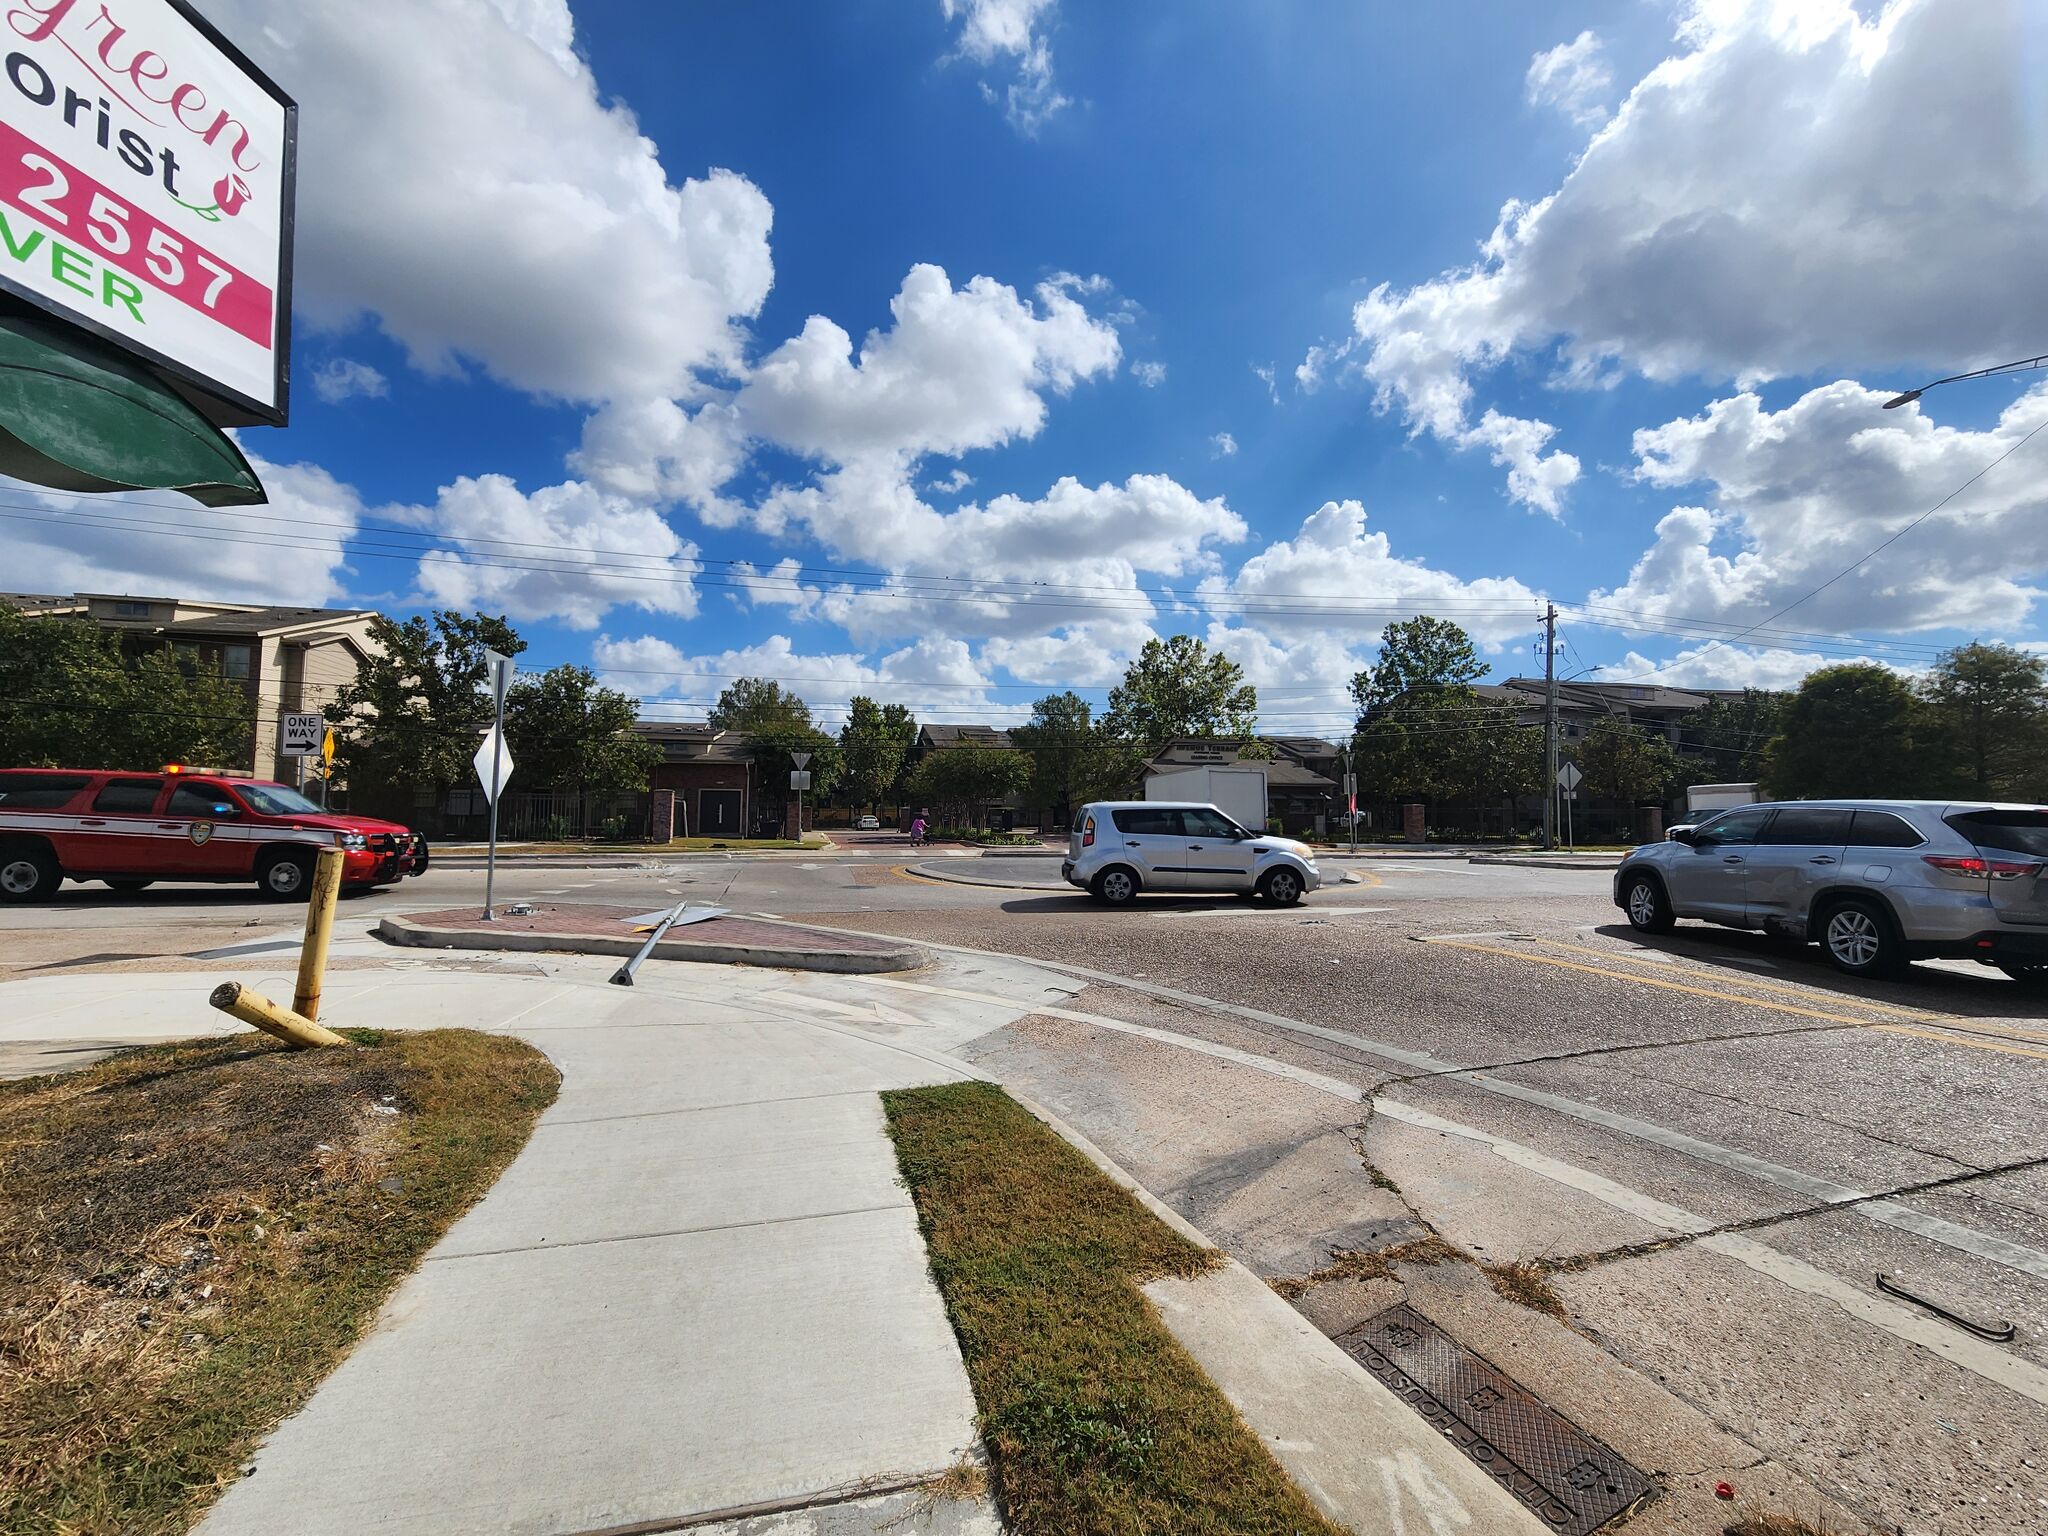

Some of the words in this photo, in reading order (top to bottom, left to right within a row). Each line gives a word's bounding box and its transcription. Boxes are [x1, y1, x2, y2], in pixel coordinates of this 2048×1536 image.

[5, 52, 180, 197] orist
[0, 210, 146, 324] VER
[288, 717, 316, 727] ONE
[288, 728, 317, 738] WAY
[1349, 1339, 1459, 1431] HOUSTON
[1447, 1431, 1496, 1462] OF
[1494, 1470, 1572, 1524] CITY
